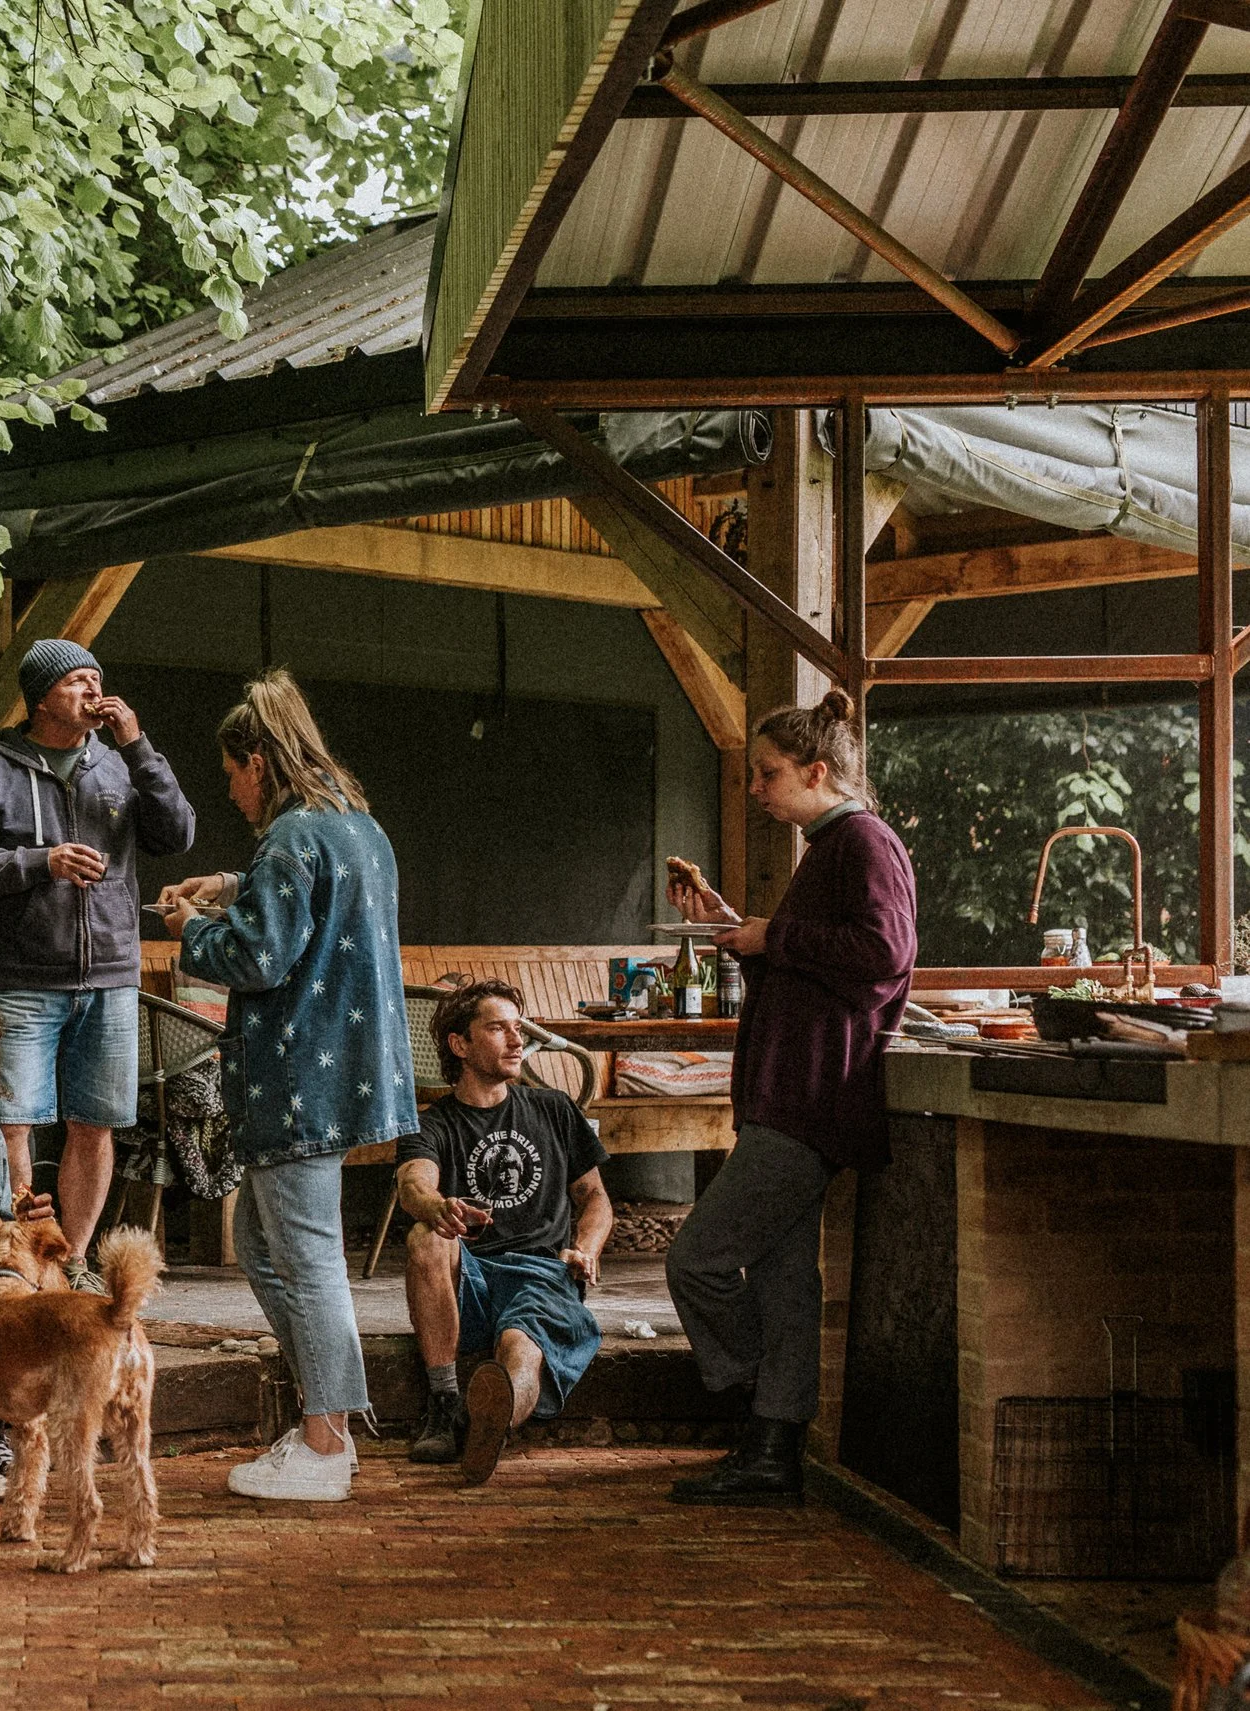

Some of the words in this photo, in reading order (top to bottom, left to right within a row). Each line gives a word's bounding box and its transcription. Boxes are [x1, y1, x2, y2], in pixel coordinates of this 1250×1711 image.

[487, 1131, 508, 1143] THE
[510, 1129, 541, 1162] BRIAN
[467, 1139, 488, 1202] MASSACRE
